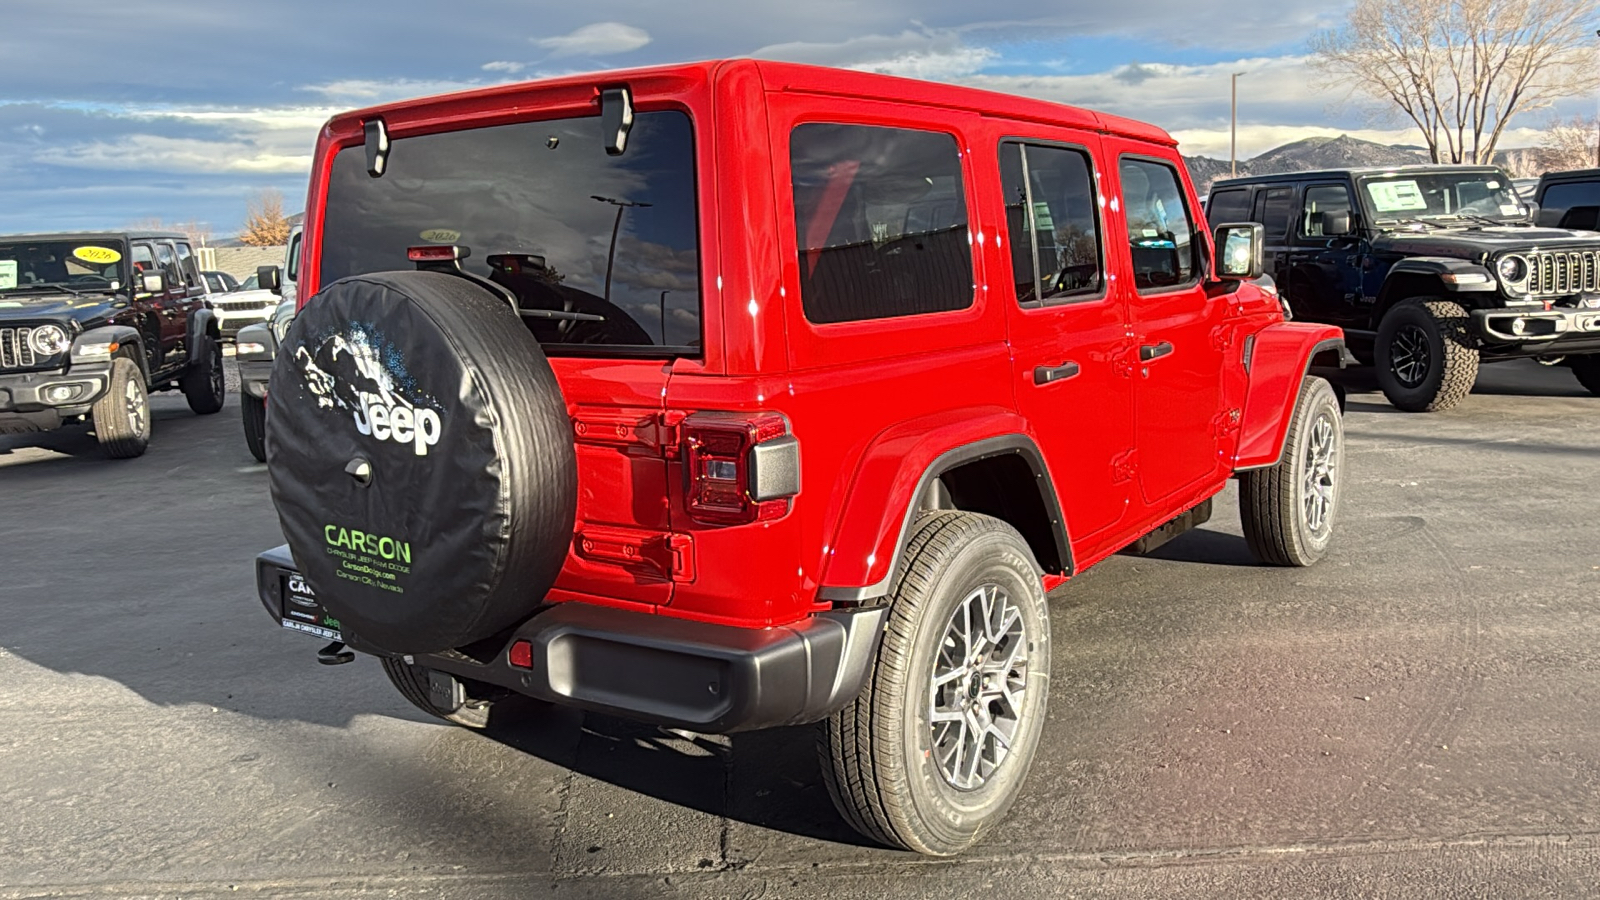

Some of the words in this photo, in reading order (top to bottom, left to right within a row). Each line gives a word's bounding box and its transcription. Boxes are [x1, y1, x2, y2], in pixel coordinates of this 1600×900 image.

[428, 231, 456, 241] 2026
[82, 249, 113, 260] 2026
[353, 391, 442, 456] Jeep
[324, 524, 412, 564] CARSON
[336, 569, 360, 582] Carson
[377, 580, 404, 594] Nevada
